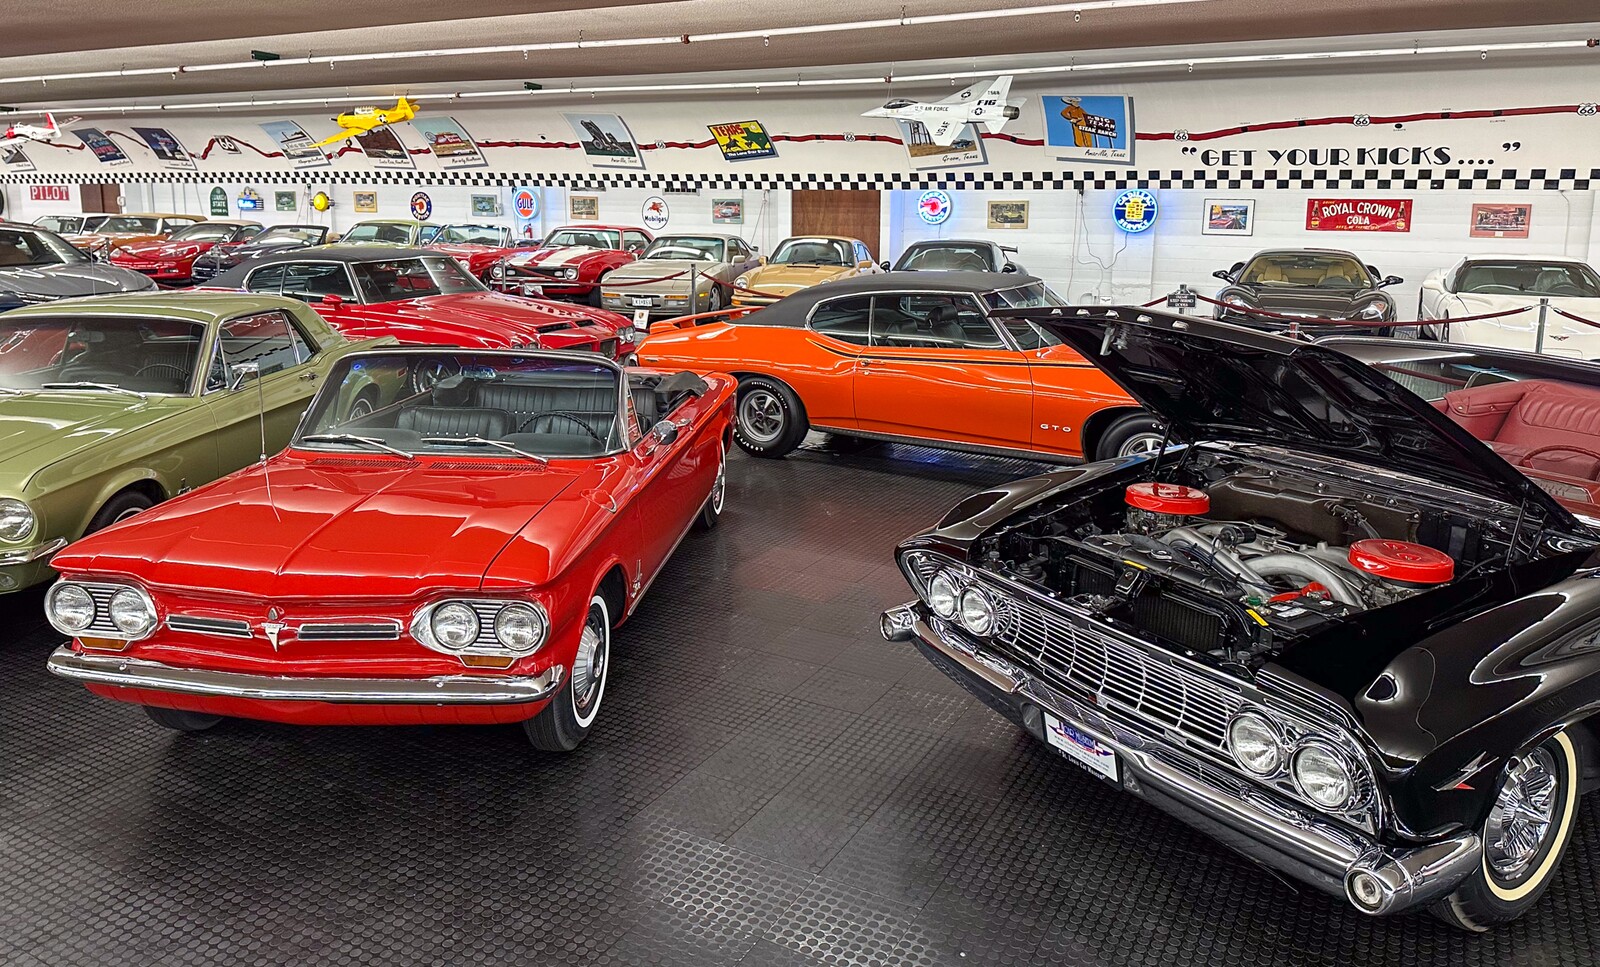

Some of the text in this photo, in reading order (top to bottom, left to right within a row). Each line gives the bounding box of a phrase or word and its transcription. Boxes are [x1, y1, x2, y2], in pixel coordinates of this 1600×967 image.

[1090, 120, 1115, 129] TEXAN
[1356, 117, 1368, 125] 66
[712, 124, 745, 137] TEXAS
[1267, 149, 1350, 166] YOUR
[31, 186, 67, 199] PILOT
[517, 198, 534, 209] GULF
[1118, 191, 1154, 206] CADILLAC
[1322, 202, 1396, 219] ROYAL CROWN
[1118, 219, 1150, 230] SERVICE
[1347, 216, 1370, 225] COLA
[1040, 424, 1071, 432] GTO
